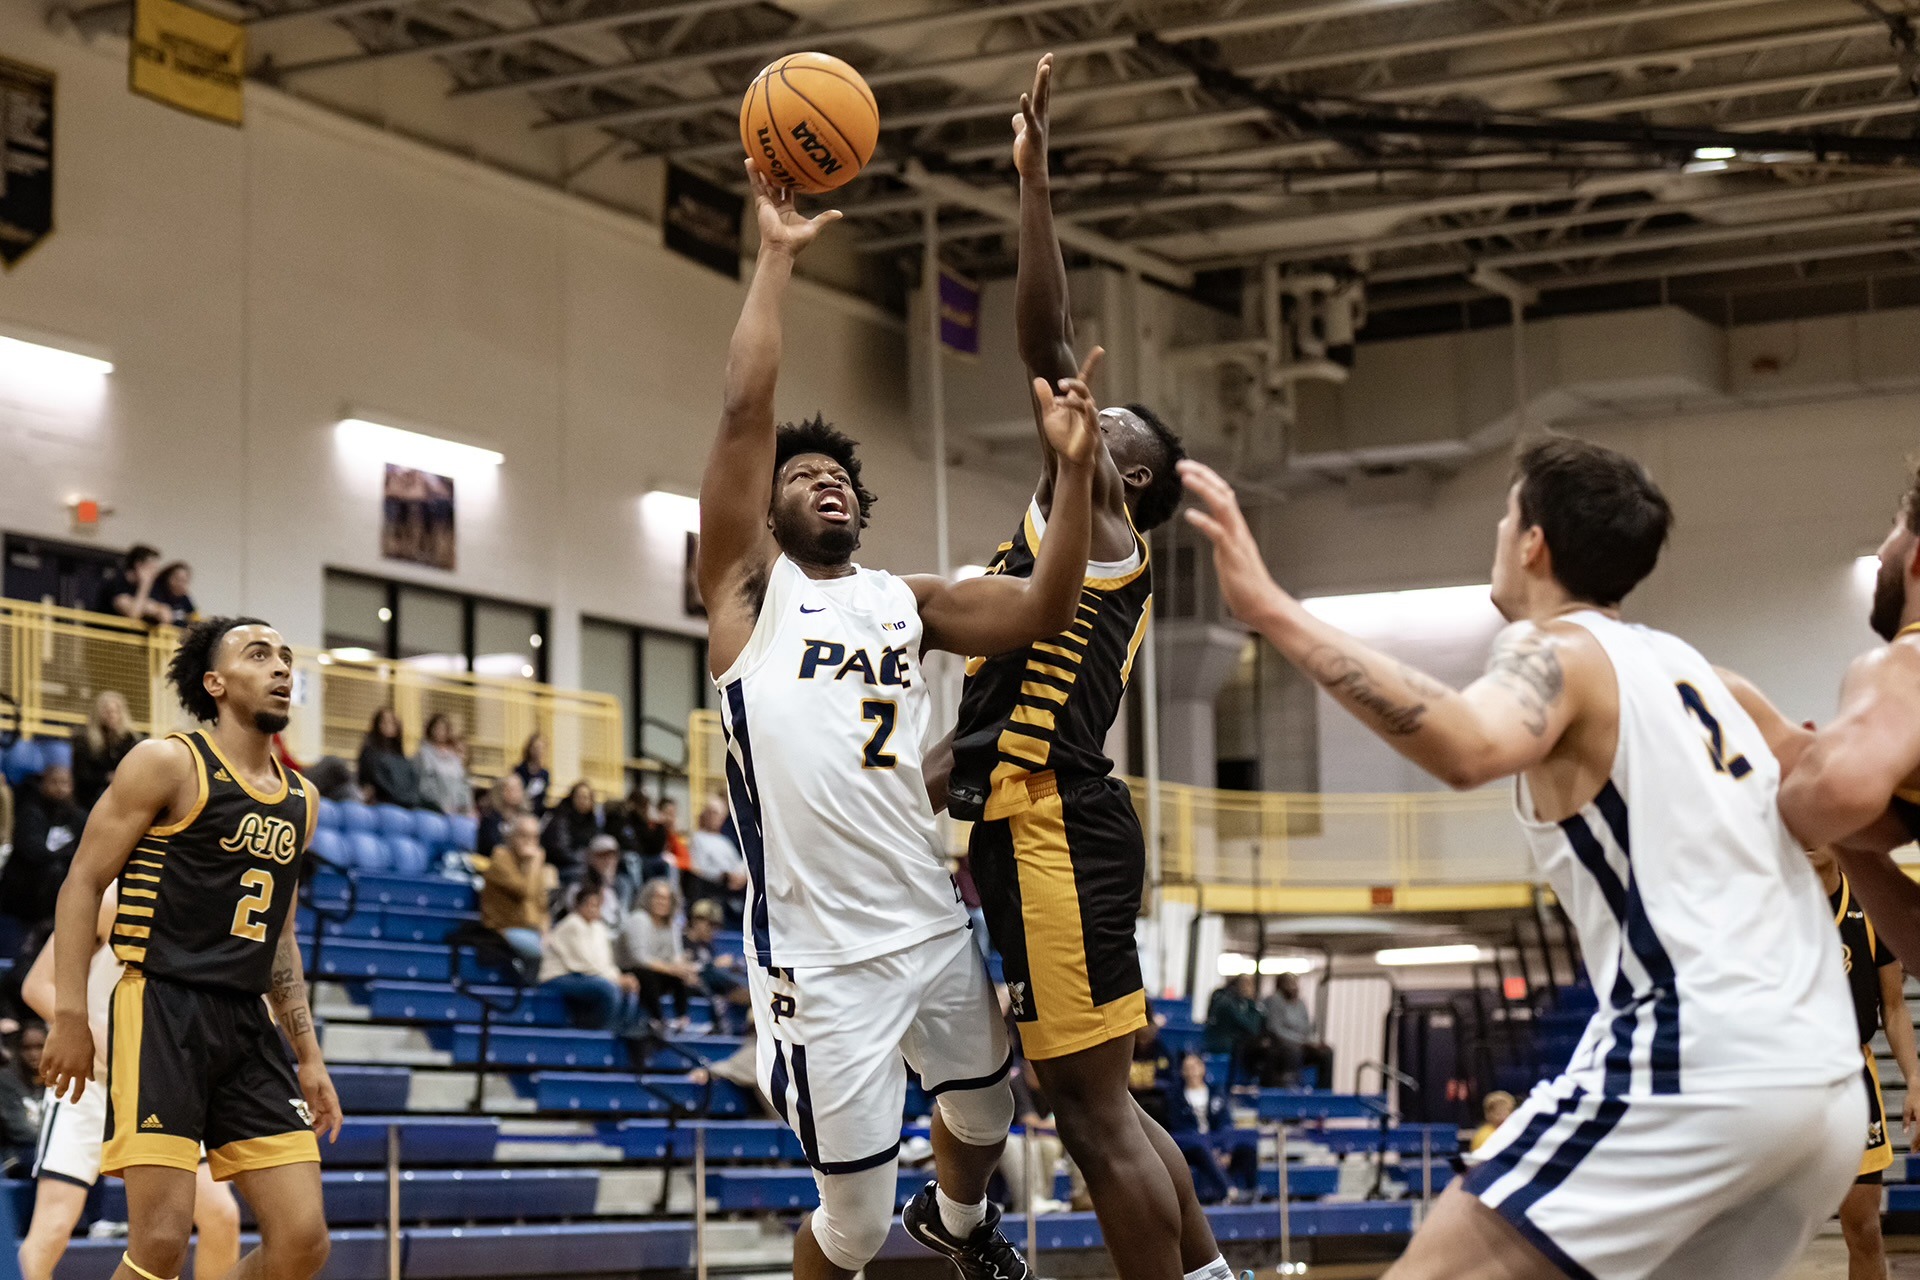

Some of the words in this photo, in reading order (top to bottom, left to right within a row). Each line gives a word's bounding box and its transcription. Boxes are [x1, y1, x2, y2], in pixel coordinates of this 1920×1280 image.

[791, 121, 842, 175] NCAA
[860, 698, 899, 770] 2
[219, 812, 296, 865] AIC
[230, 867, 274, 943] 2
